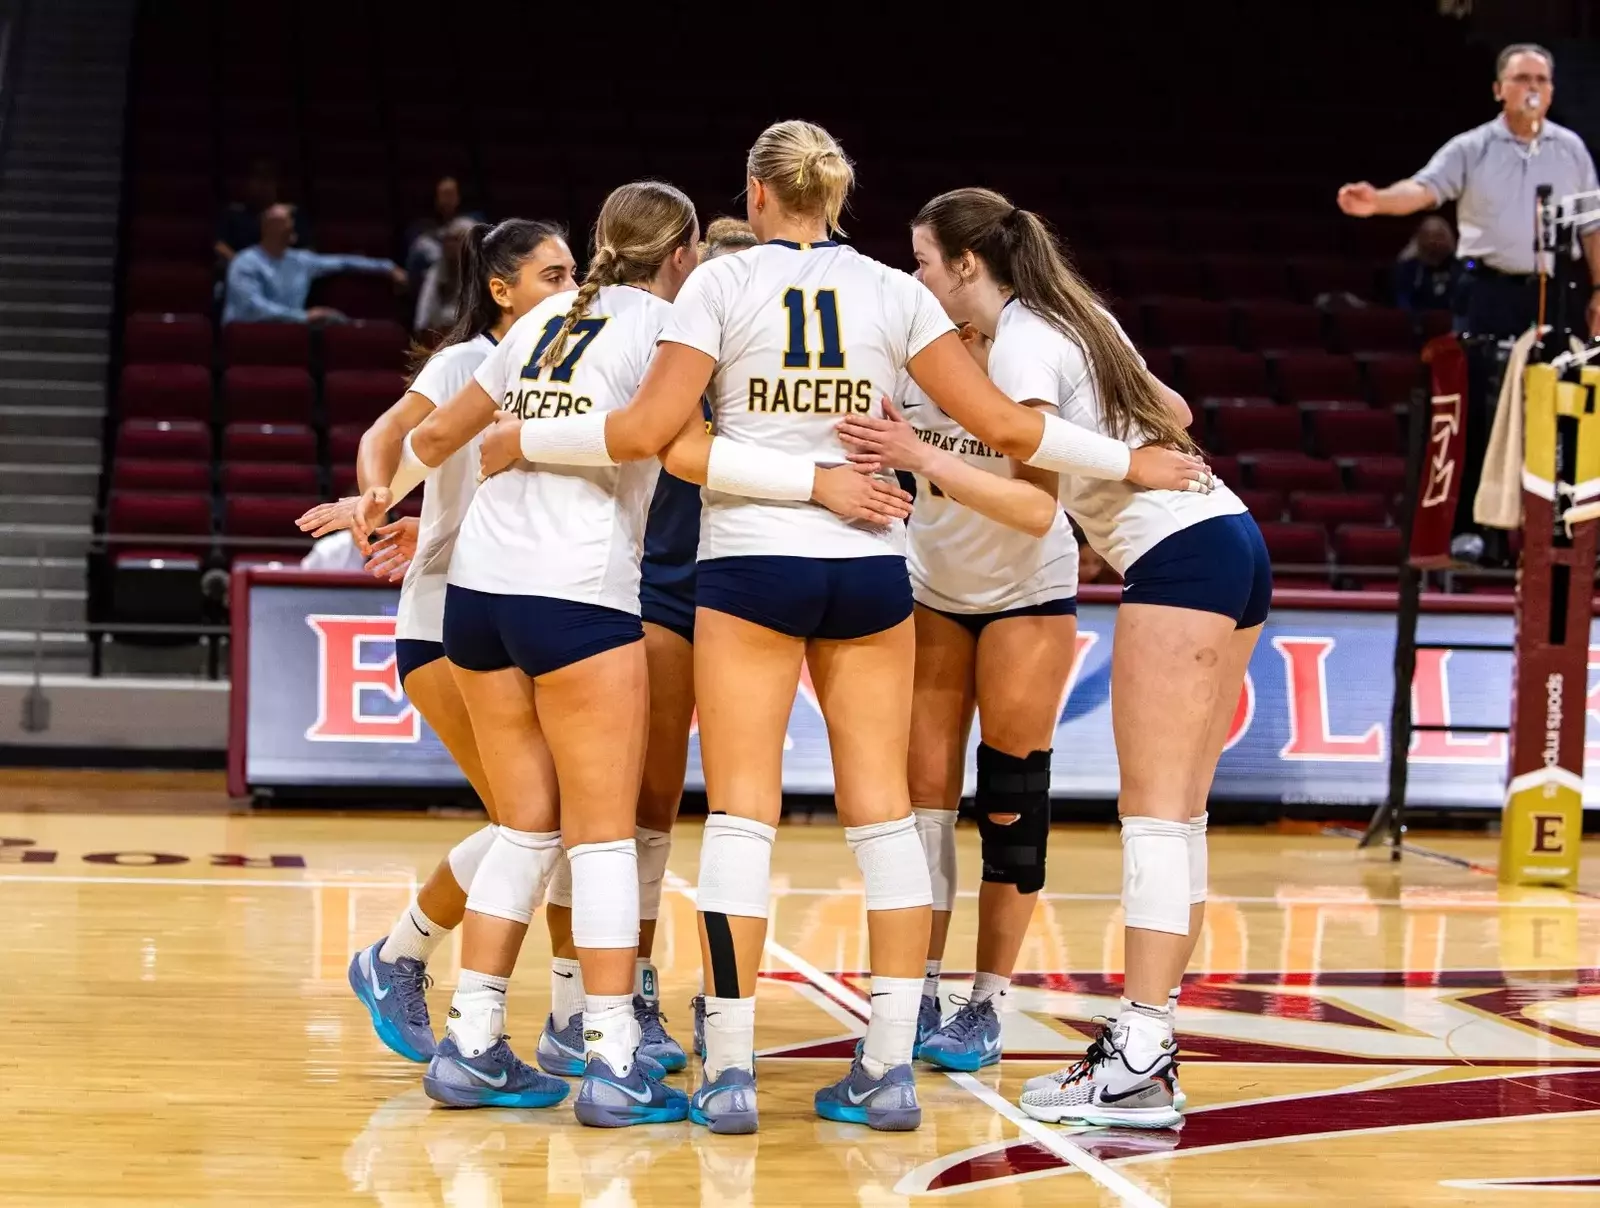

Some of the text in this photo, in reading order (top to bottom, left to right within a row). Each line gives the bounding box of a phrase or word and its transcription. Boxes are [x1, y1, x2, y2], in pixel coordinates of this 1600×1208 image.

[520, 314, 611, 385] 17
[782, 286, 846, 370] 11
[747, 377, 873, 413] RACERS
[1530, 813, 1566, 854] E
